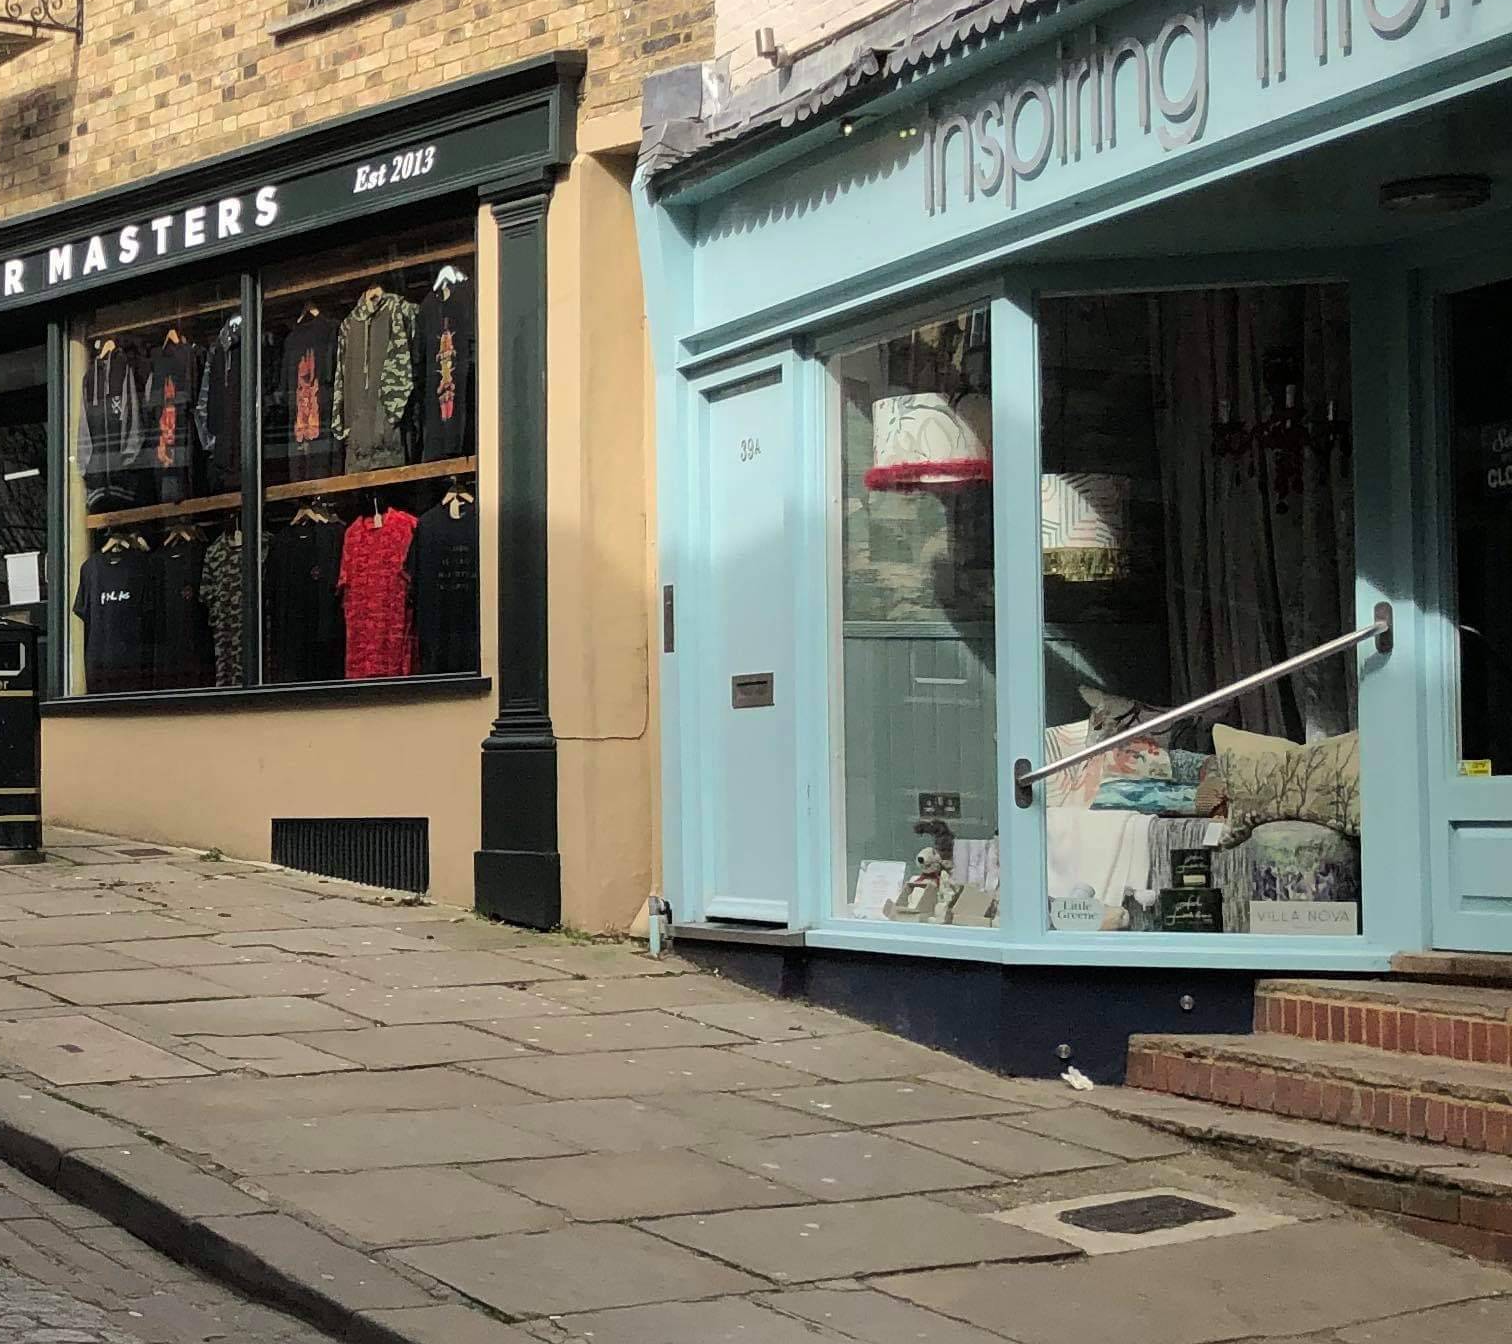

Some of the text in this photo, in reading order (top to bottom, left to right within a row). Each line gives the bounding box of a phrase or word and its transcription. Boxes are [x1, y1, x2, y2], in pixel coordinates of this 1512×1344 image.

[924, 6, 1208, 213] inspiring
[352, 145, 437, 193] Est 2013
[48, 185, 279, 285] MASTERS
[1257, 909, 1351, 923] VILLA NOVA
